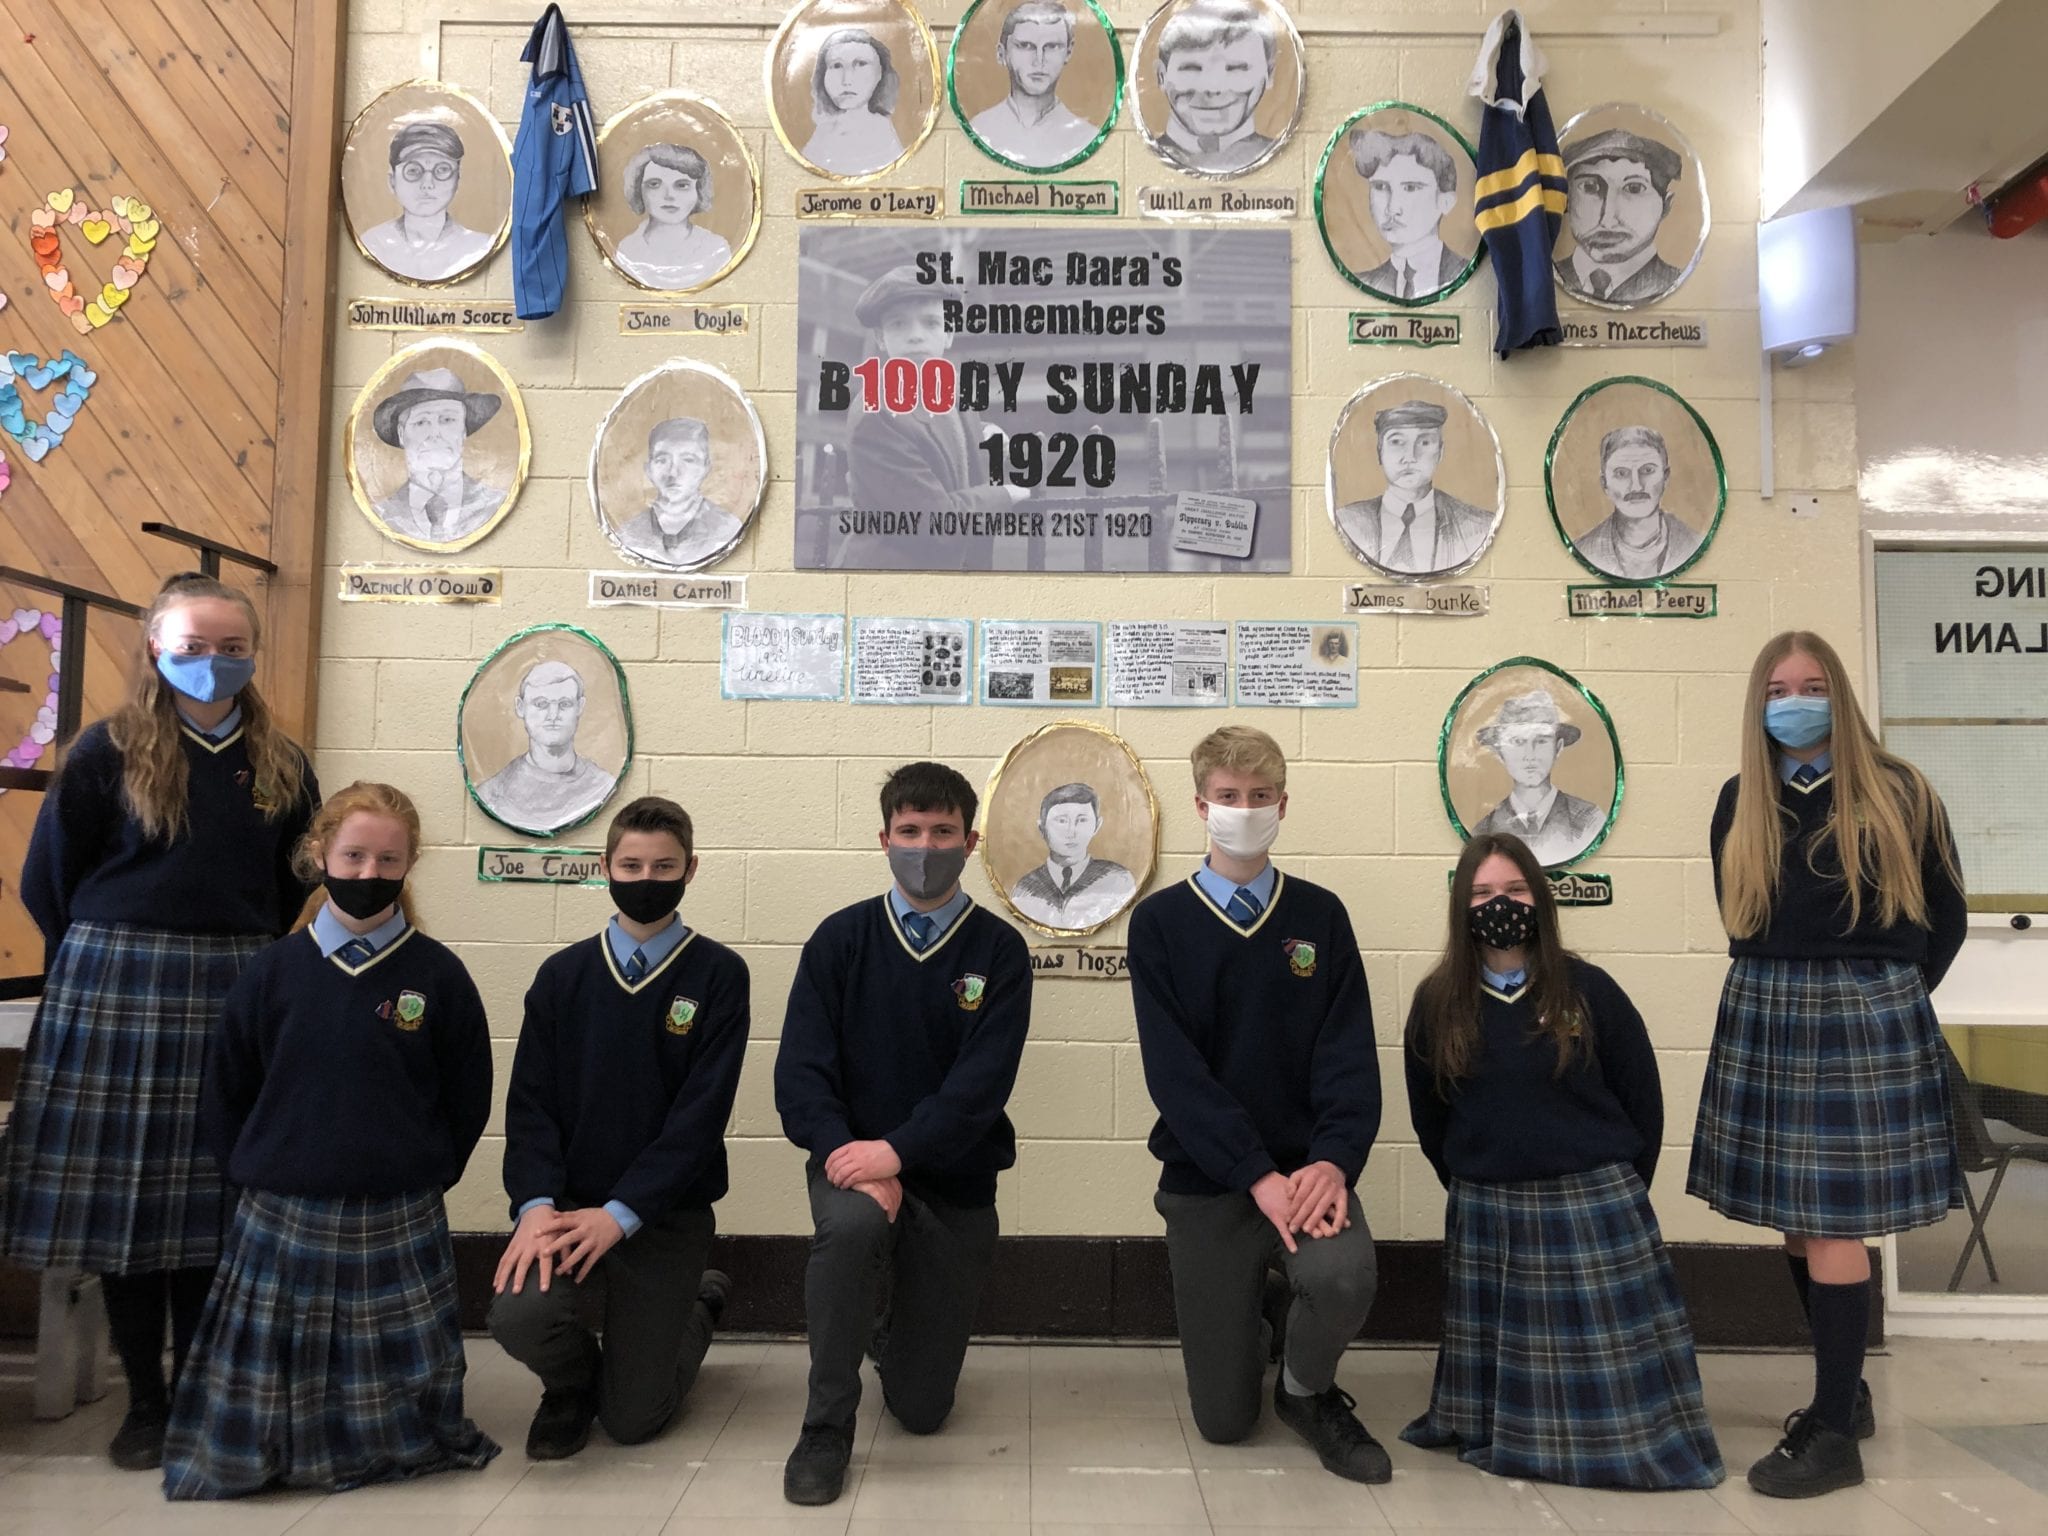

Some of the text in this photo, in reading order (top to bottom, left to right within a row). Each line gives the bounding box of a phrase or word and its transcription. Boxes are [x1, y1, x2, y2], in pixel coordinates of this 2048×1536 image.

[801, 193, 862, 213] Jerome
[970, 184, 1039, 206] Michael
[1221, 192, 1294, 211] Robinson
[915, 250, 1182, 287] St. Mac Dara's
[352, 304, 513, 325] John William Scott
[942, 299, 1166, 335] Remembers
[1356, 318, 1455, 343] Tom Ryan
[1606, 320, 1701, 340] Matthews
[818, 357, 1261, 415] B100DY SUNDAY
[979, 432, 1116, 488] 1920
[838, 511, 922, 535] SUNDAY
[929, 511, 1044, 537] NOVEMBER
[1051, 512, 1098, 537] 21ST
[1104, 512, 1152, 538] 1920
[600, 579, 732, 599] Daniel Carroll
[1350, 588, 1405, 607] James
[1575, 589, 1706, 614] Michael Feery
[488, 854, 524, 876] Joe
